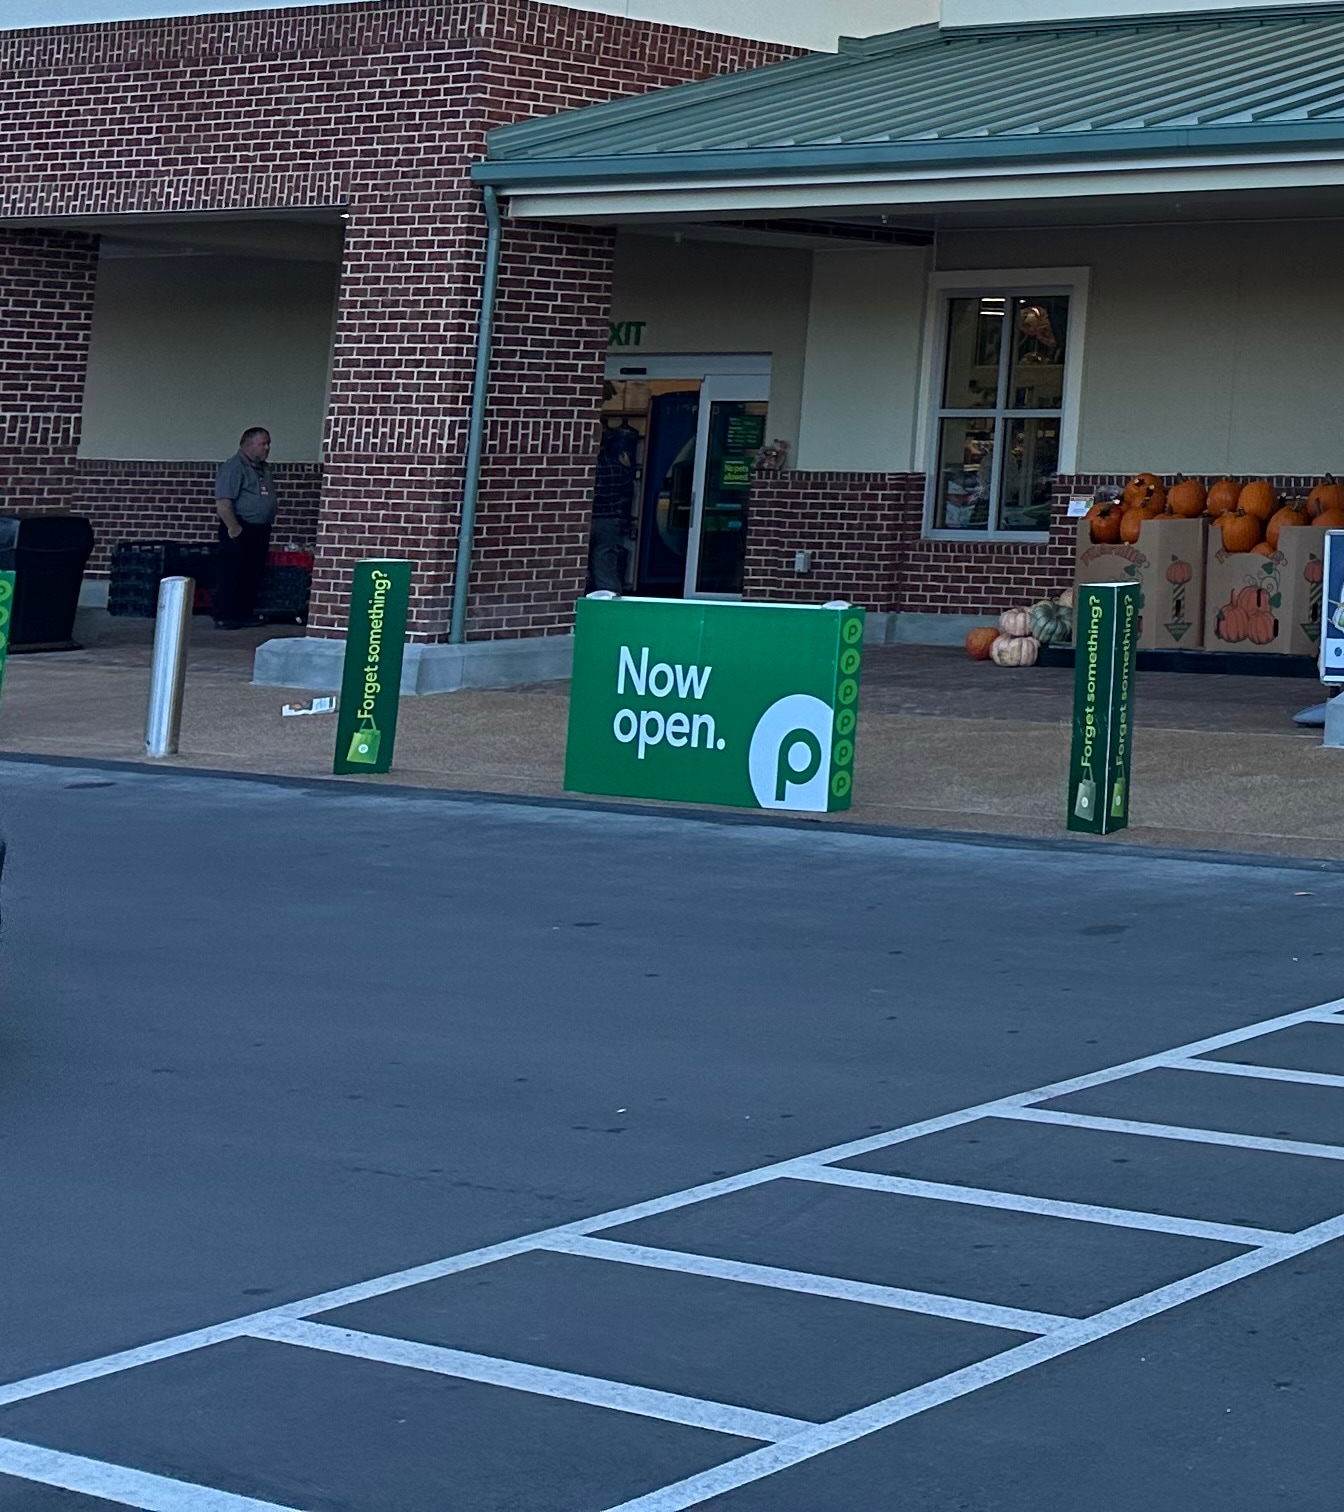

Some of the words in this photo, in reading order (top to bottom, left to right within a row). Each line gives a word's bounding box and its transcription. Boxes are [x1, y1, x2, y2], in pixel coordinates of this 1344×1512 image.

[607, 321, 647, 347] XIT
[367, 569, 392, 663] something?
[1120, 593, 1133, 701] something?
[617, 645, 713, 700] Now
[1087, 594, 1103, 703] something?
[357, 665, 381, 719] Forget
[613, 708, 726, 760] open.
[1081, 705, 1097, 768] Forget
[1116, 703, 1127, 766] Forget
